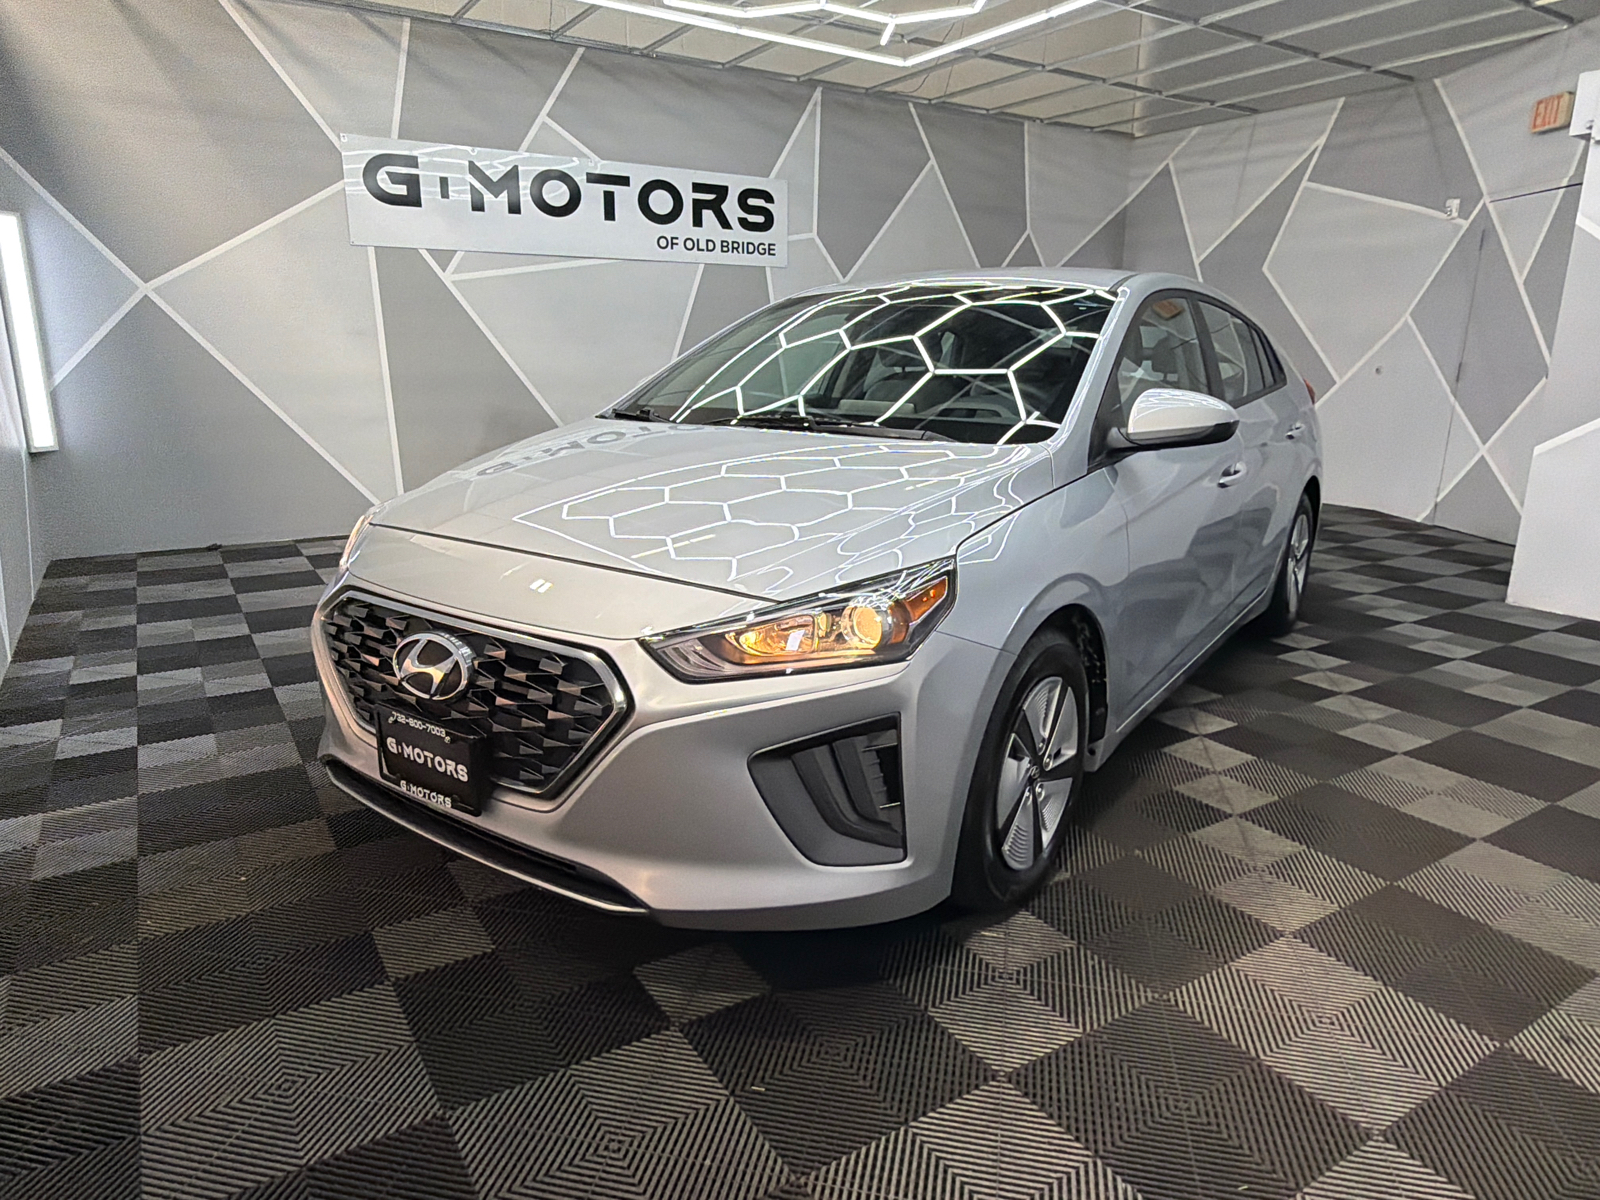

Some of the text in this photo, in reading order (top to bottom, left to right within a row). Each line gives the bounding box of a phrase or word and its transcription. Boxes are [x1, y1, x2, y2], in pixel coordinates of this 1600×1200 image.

[1531, 93, 1564, 129] EXIT
[657, 235, 776, 256] OF OLD BRIDGE
